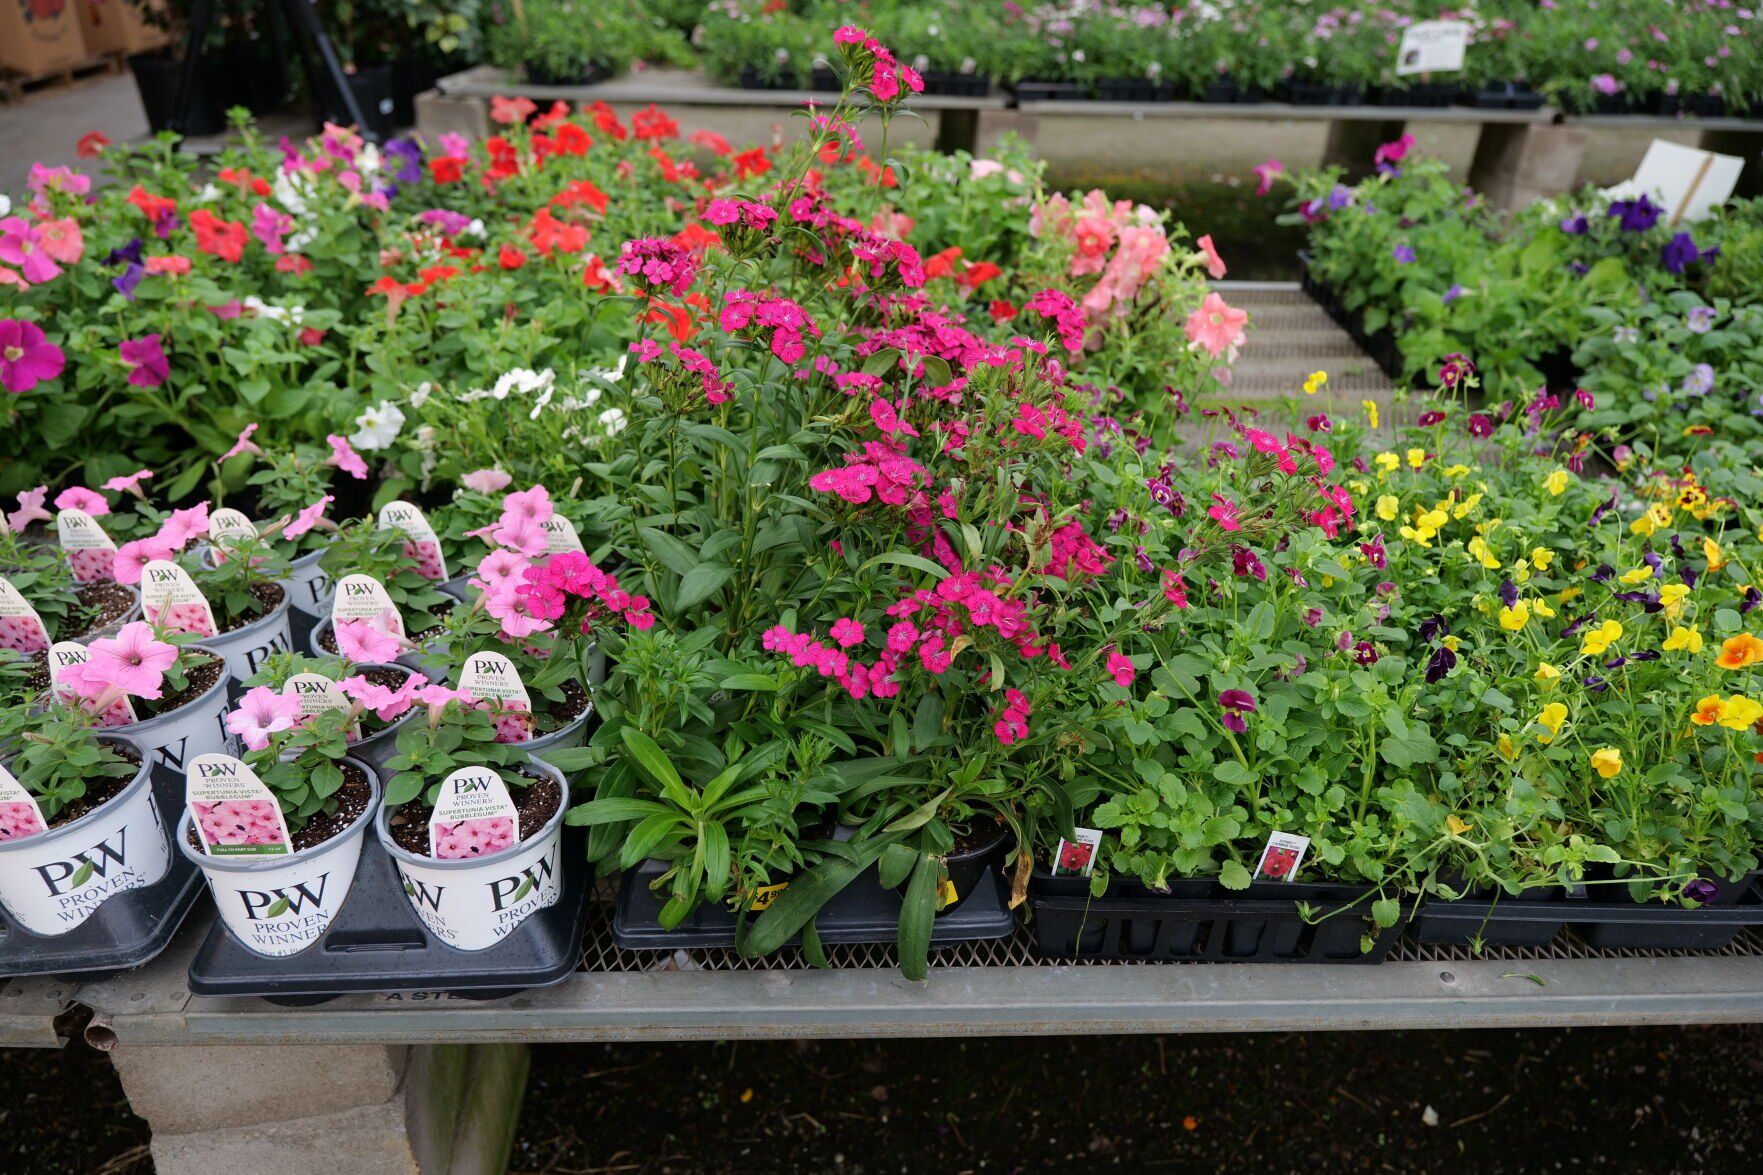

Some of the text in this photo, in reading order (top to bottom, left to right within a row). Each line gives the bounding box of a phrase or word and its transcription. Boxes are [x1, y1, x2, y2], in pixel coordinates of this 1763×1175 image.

[63, 516, 88, 528] PW
[215, 515, 240, 529] PW
[386, 509, 413, 522] PW
[149, 569, 178, 582] PW
[345, 583, 374, 595] PW
[55, 650, 87, 665] PW
[474, 660, 507, 675] PW
[293, 681, 328, 693] PW
[197, 763, 237, 777] PW
[453, 775, 493, 795] PW
[452, 798, 494, 807] WINNERS
[456, 792, 489, 801] PROVEN
[438, 807, 483, 816] SUPERTUNIA
[450, 811, 495, 820] BUBBLEGUM
[30, 824, 128, 898] PW
[485, 840, 558, 913] PW
[58, 865, 135, 909] PROVEN
[234, 870, 330, 920] PW
[254, 909, 329, 933] PROVEN
[252, 924, 327, 945] WINNER
